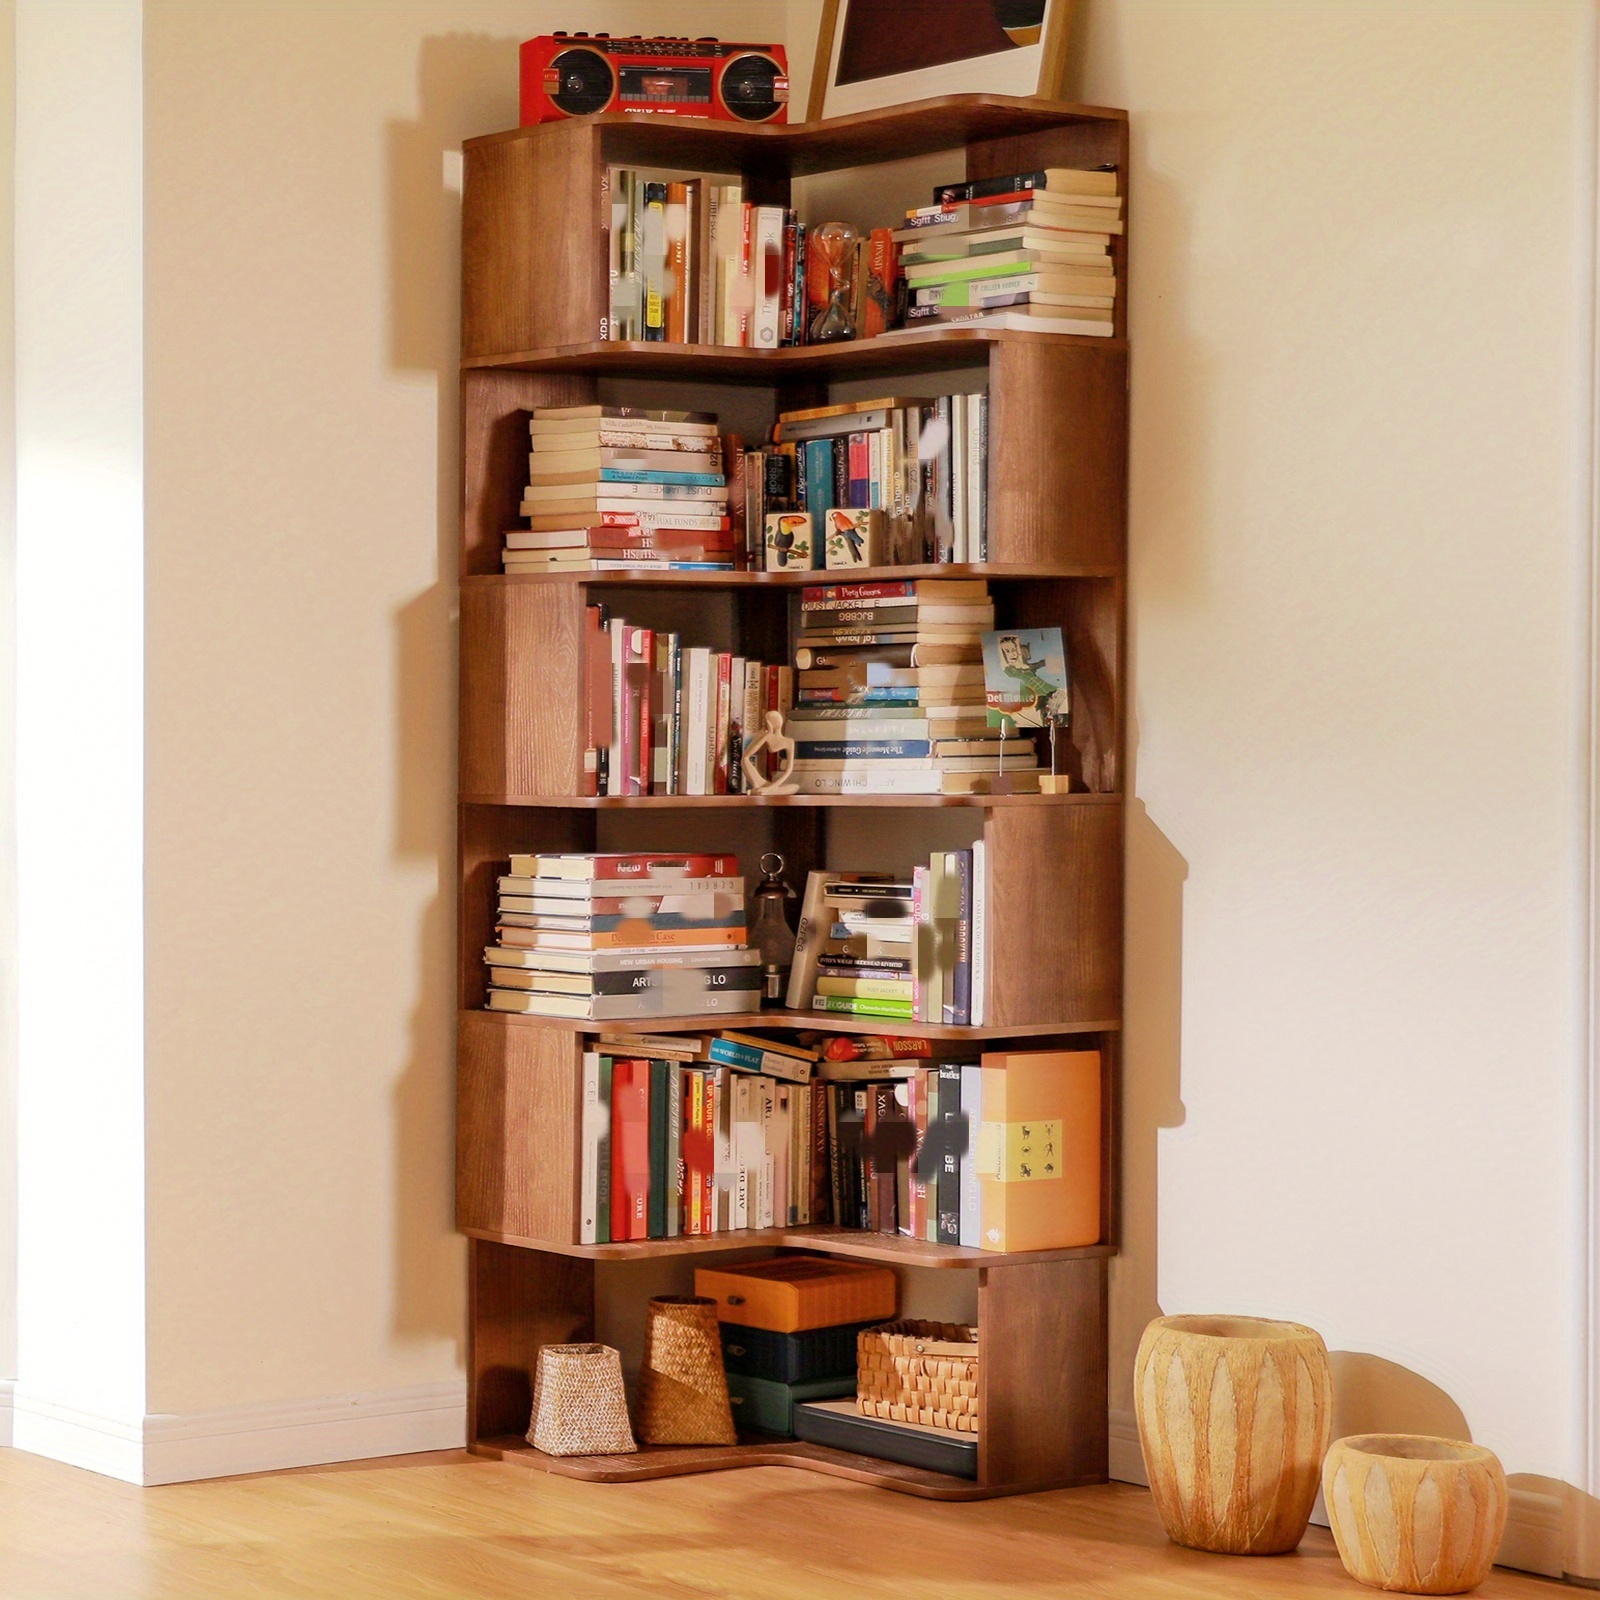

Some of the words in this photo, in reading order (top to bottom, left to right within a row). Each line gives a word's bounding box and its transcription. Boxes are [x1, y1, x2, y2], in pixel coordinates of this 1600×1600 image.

[980, 281, 1000, 291] COLLEEN
[600, 317, 608, 340] XDD
[987, 693, 1002, 703] Del
[842, 747, 861, 755] Guide
[815, 779, 826, 787] LO
[690, 881, 734, 890] CEREAL
[656, 932, 675, 940] Case
[893, 1038, 927, 1051] LARSSON
[719, 1049, 740, 1059] WORLD
[744, 1055, 760, 1063] FLAT
[940, 1070, 960, 1080] beatles
[706, 1085, 713, 1097] UP
[945, 1155, 954, 1173] BE
[599, 1169, 608, 1204] BOOK
[970, 1196, 976, 1211] LO
